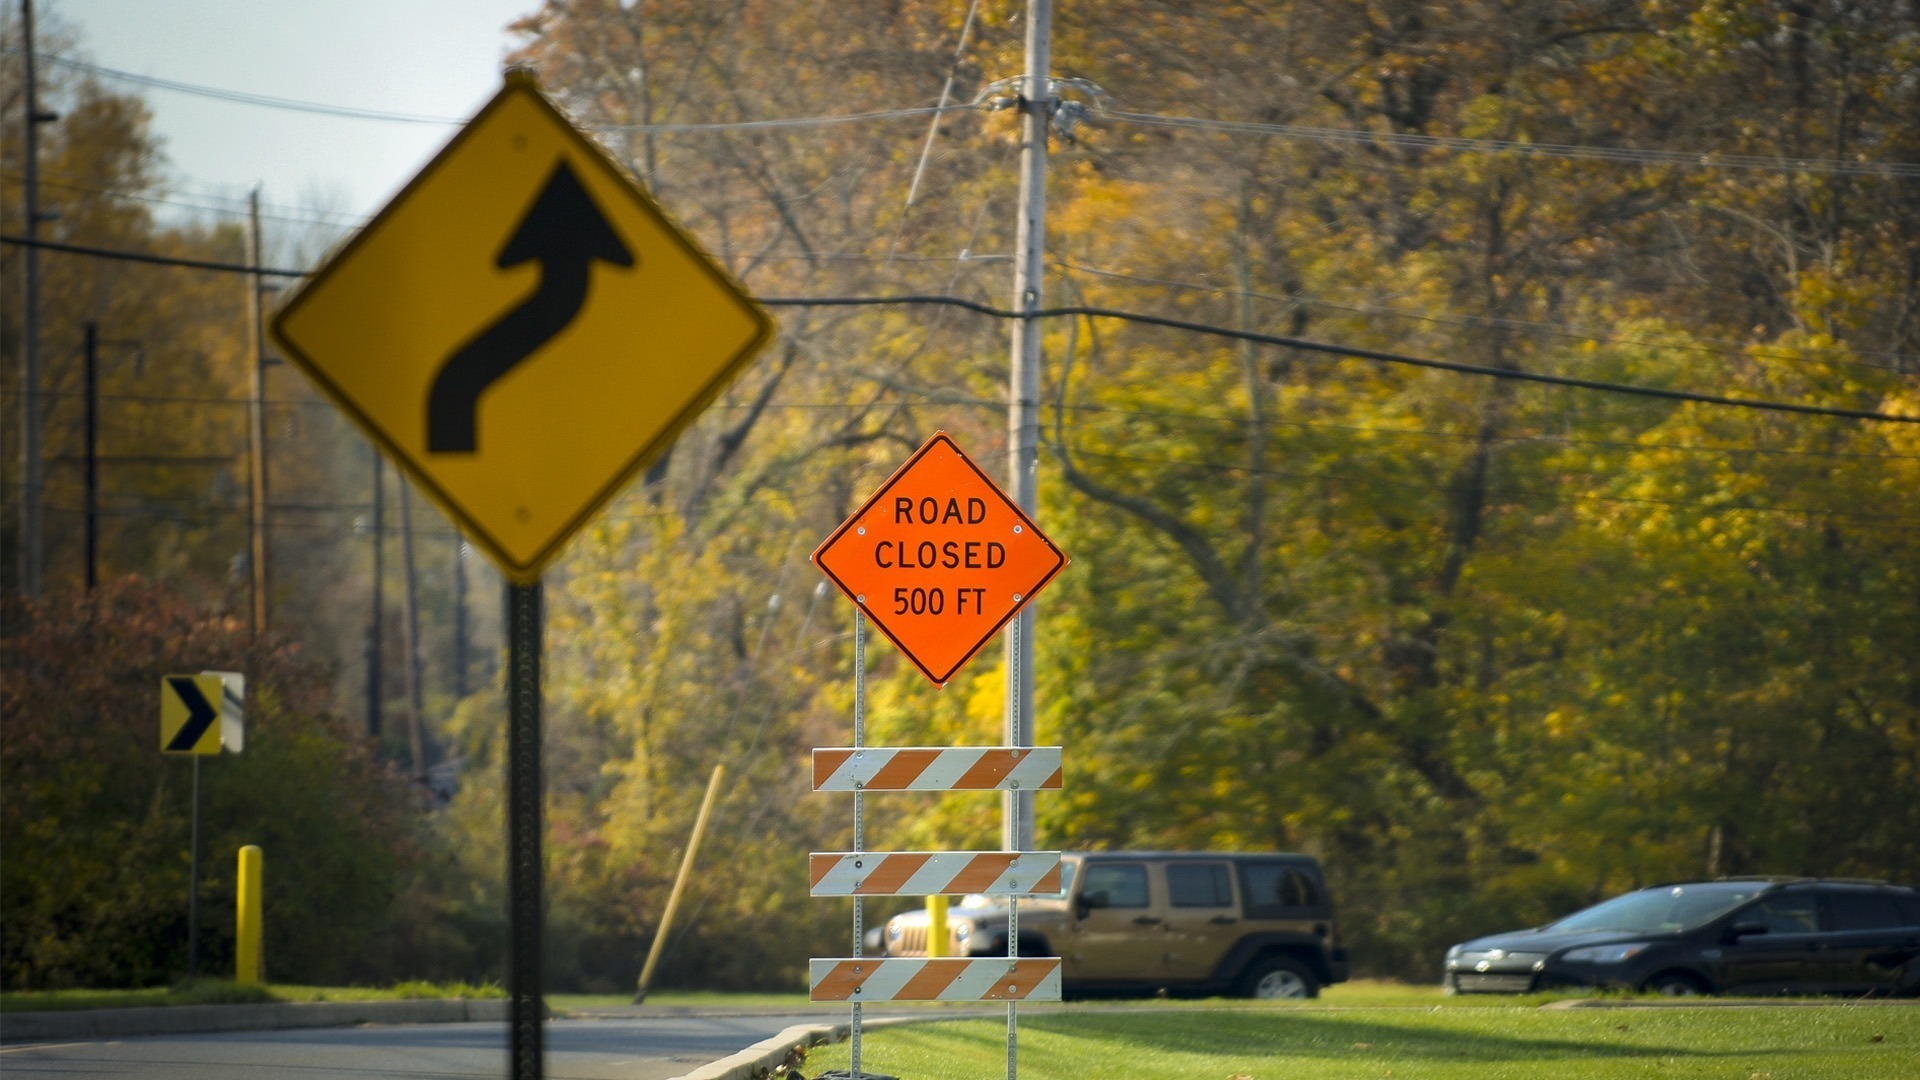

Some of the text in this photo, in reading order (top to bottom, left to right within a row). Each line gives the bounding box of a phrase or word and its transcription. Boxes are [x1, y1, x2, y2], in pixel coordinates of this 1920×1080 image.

[895, 497, 986, 524] ROAD
[875, 541, 1006, 569] CLOSED
[894, 588, 986, 615] 500 FT
